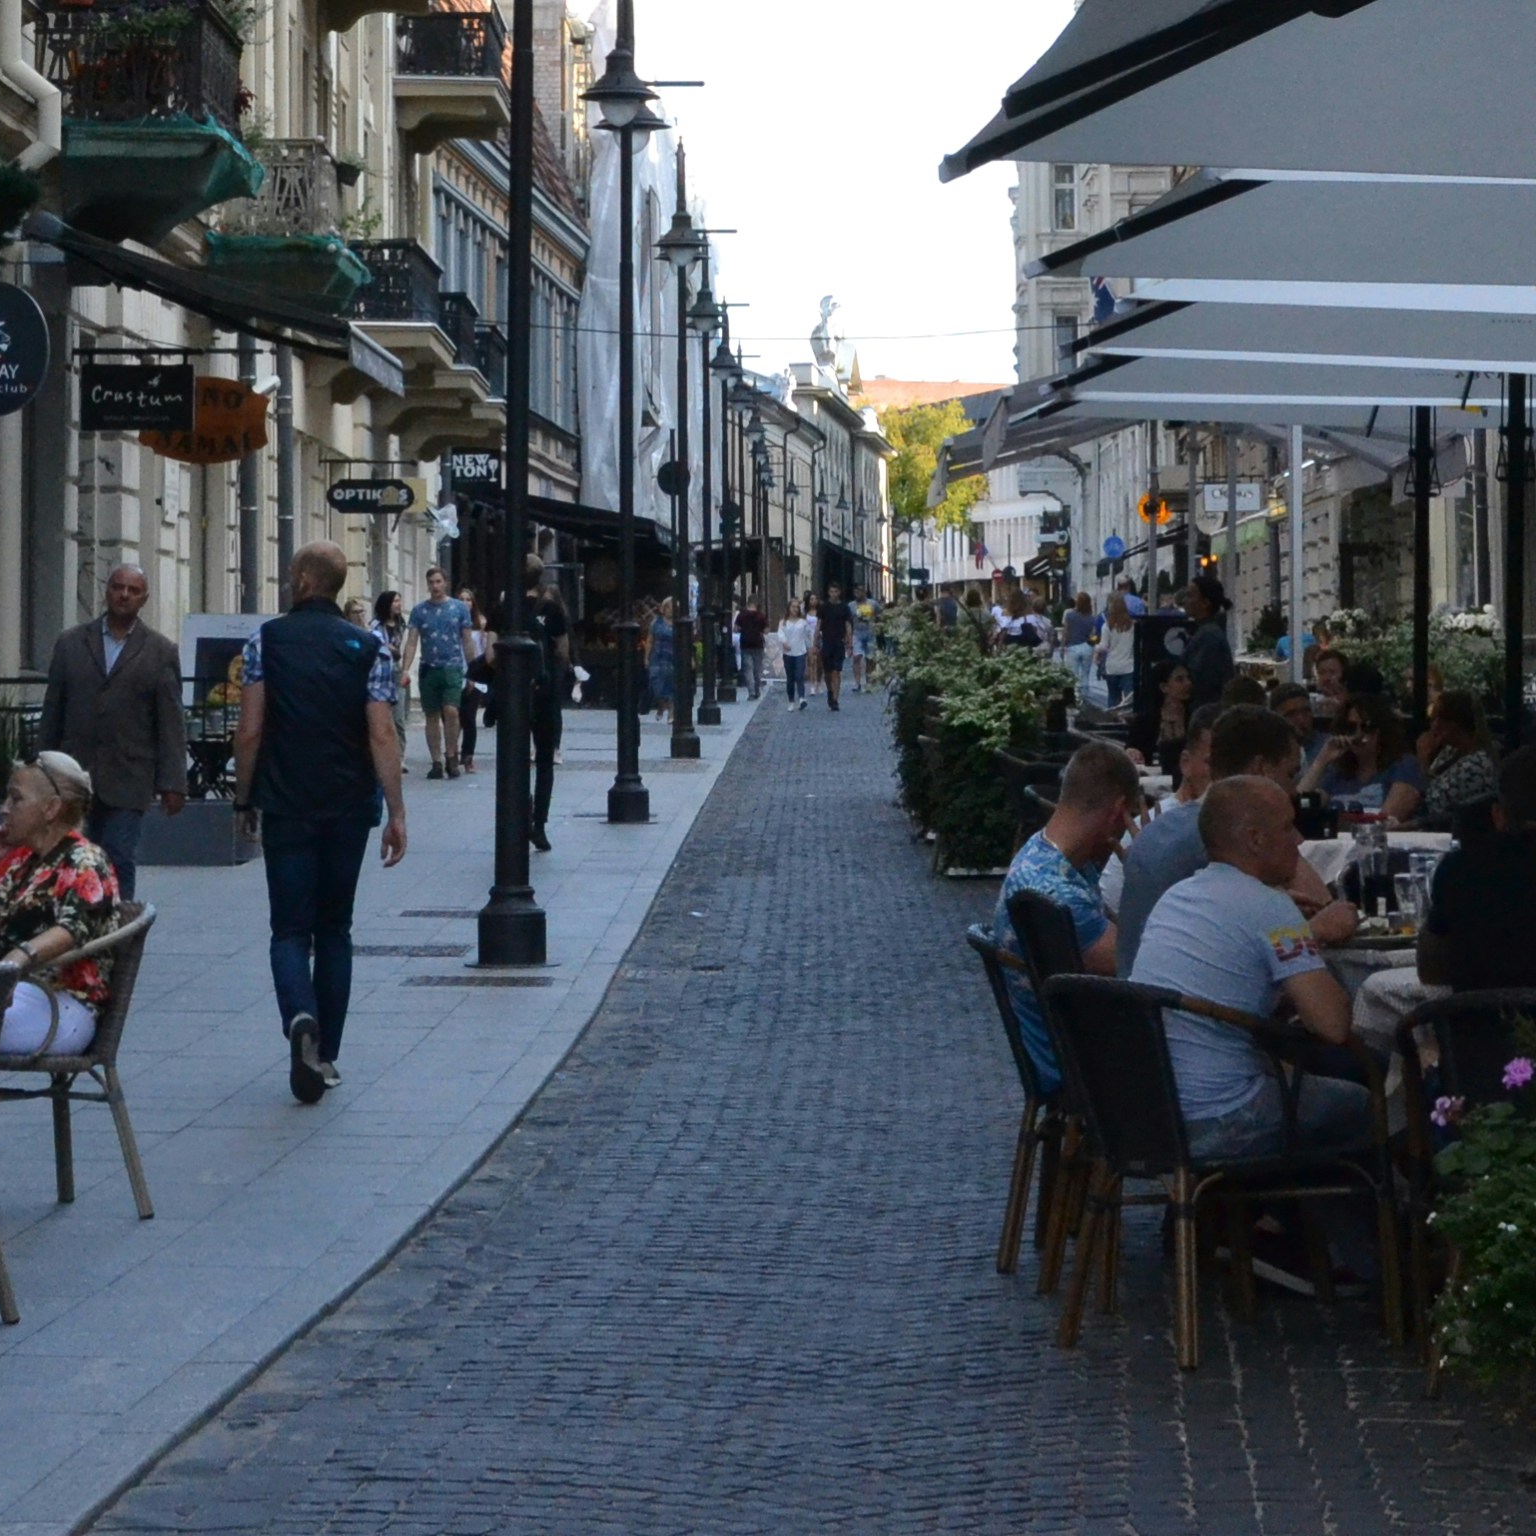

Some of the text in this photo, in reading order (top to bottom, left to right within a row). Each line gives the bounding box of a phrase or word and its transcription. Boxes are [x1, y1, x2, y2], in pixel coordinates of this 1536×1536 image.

[90, 384, 183, 409] Crustum
[452, 454, 490, 469] NEW
[455, 465, 488, 478] TON
[332, 488, 409, 501] OPTIKS
